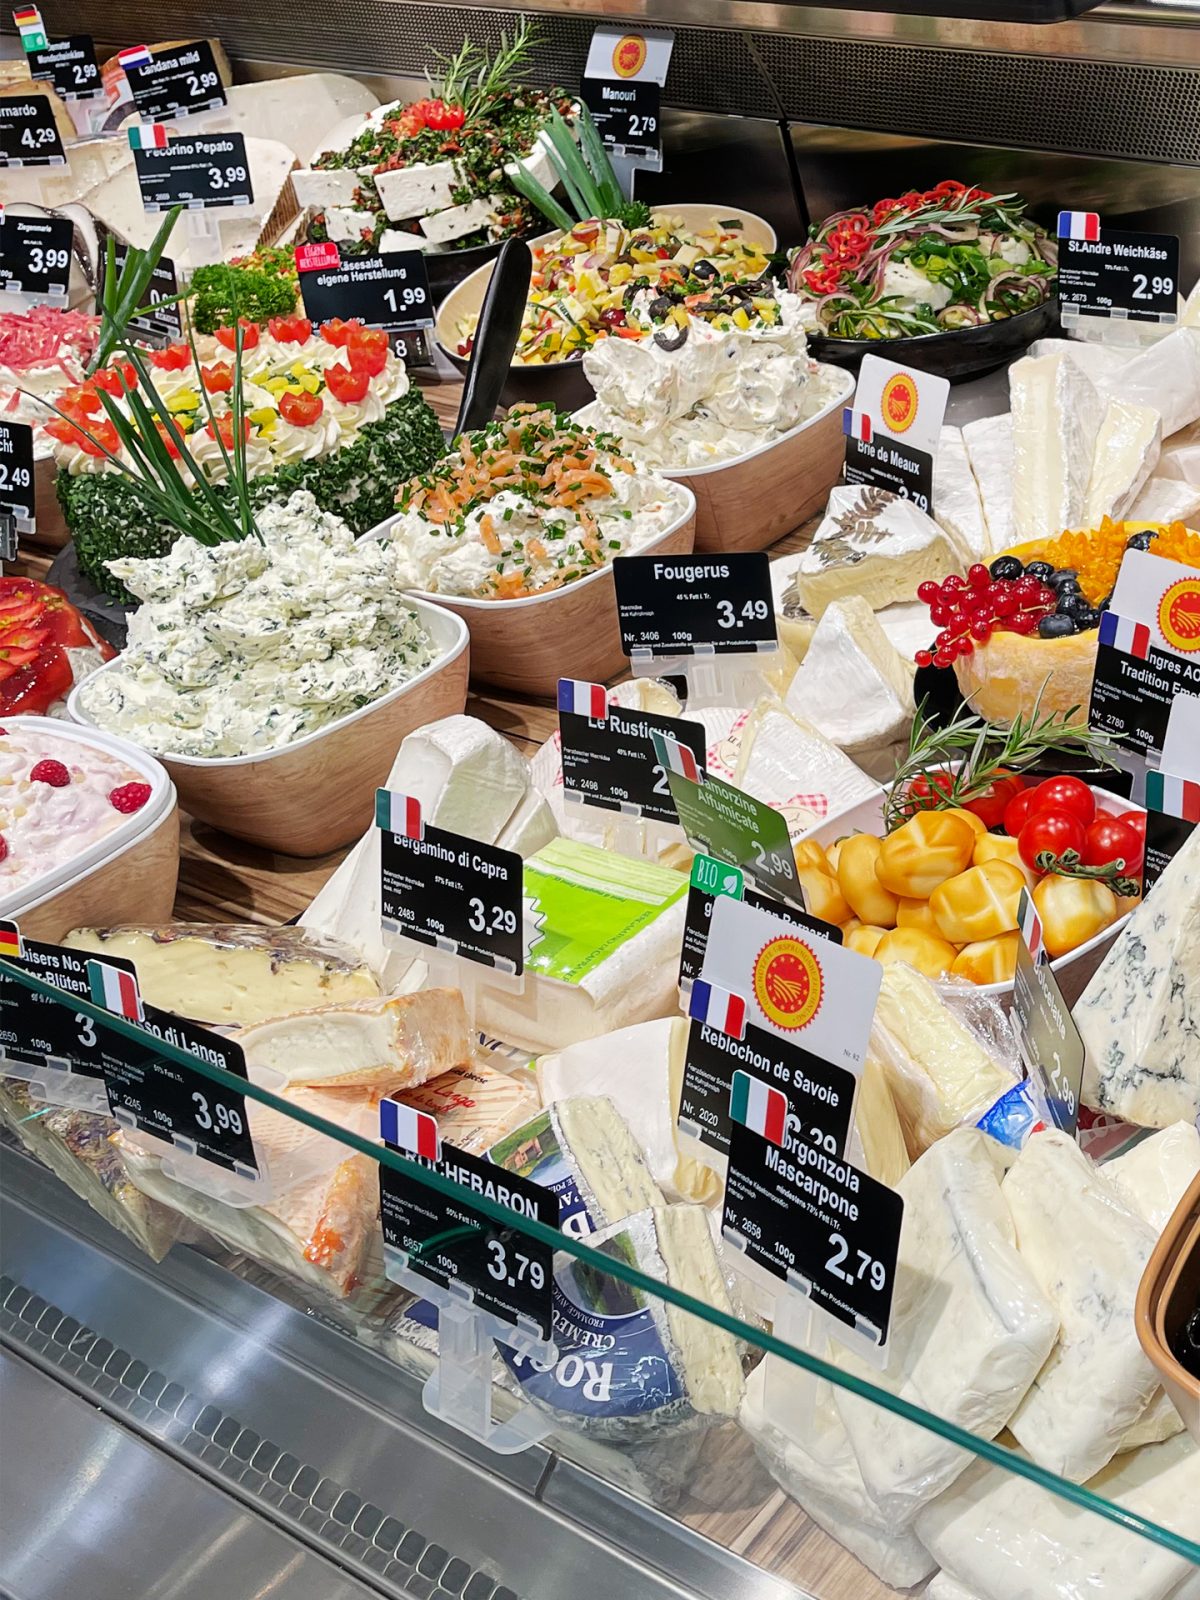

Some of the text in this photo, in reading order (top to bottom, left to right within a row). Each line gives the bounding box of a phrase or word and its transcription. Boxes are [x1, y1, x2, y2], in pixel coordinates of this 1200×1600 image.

[72, 64, 97, 84] 2.99
[138, 50, 200, 76] Landana mild
[187, 72, 218, 96] 2.99
[602, 87, 636, 101] Manouri
[0, 104, 37, 117] rnardo
[21, 128, 56, 148] 4.29
[628, 115, 656, 136] 2.79
[146, 140, 234, 158] Pecorino Pepato
[208, 167, 246, 189] 3.99
[28, 248, 68, 274] 3.99
[1113, 244, 1168, 260] Weichkäse
[0, 270, 13, 279] 00g
[317, 268, 406, 287] eigene Herstellung
[1132, 274, 1173, 300] 2.99
[383, 287, 426, 312] 1.99
[1096, 296, 1112, 306] 100g
[857, 438, 920, 475] Brie de Meaux
[654, 563, 730, 582] Fougerus
[717, 600, 768, 628] 3.49
[624, 632, 692, 642] Nr. 3406 100g
[1120, 660, 1169, 692] Tradition
[1149, 653, 1181, 674] ngres
[588, 714, 676, 740] Le Rustiue
[1091, 708, 1103, 721] Nr.
[1107, 714, 1124, 729] 2780
[1136, 728, 1154, 744] 100g
[565, 776, 628, 799] Nr. 2498 100g
[704, 778, 757, 816] amorzine
[698, 789, 759, 833] Affumicate
[394, 833, 508, 881] Bergamino di Capra
[751, 841, 793, 880] 2.99
[697, 859, 718, 888] BIO
[383, 902, 445, 933] Nr. 2483 100g
[469, 898, 517, 936] 3.29
[24, 946, 85, 974] aisers No.
[682, 961, 695, 975] Nr.
[31, 1038, 52, 1052] 100g
[165, 1027, 178, 1046] di
[181, 1032, 228, 1069] Langa
[700, 1026, 771, 1072] Reblochon
[773, 1061, 790, 1082] de
[793, 1069, 839, 1107] Savoie
[153, 1109, 173, 1127] 100g
[192, 1092, 243, 1135] 3.99
[682, 1100, 718, 1127] Nr. 2020
[783, 1134, 860, 1194] orgonzola
[765, 1146, 859, 1221] Mascarpone
[818, 1210, 830, 1224] Fett
[726, 1207, 796, 1265] Nr. 2658 100g
[385, 1227, 400, 1244] Nr.
[437, 1254, 458, 1274] 100g
[825, 1233, 886, 1291] 2.79
[487, 1240, 545, 1290] 3.79
[567, 1303, 605, 1329] FROMAGE
[552, 1309, 616, 1350] CREMEU
